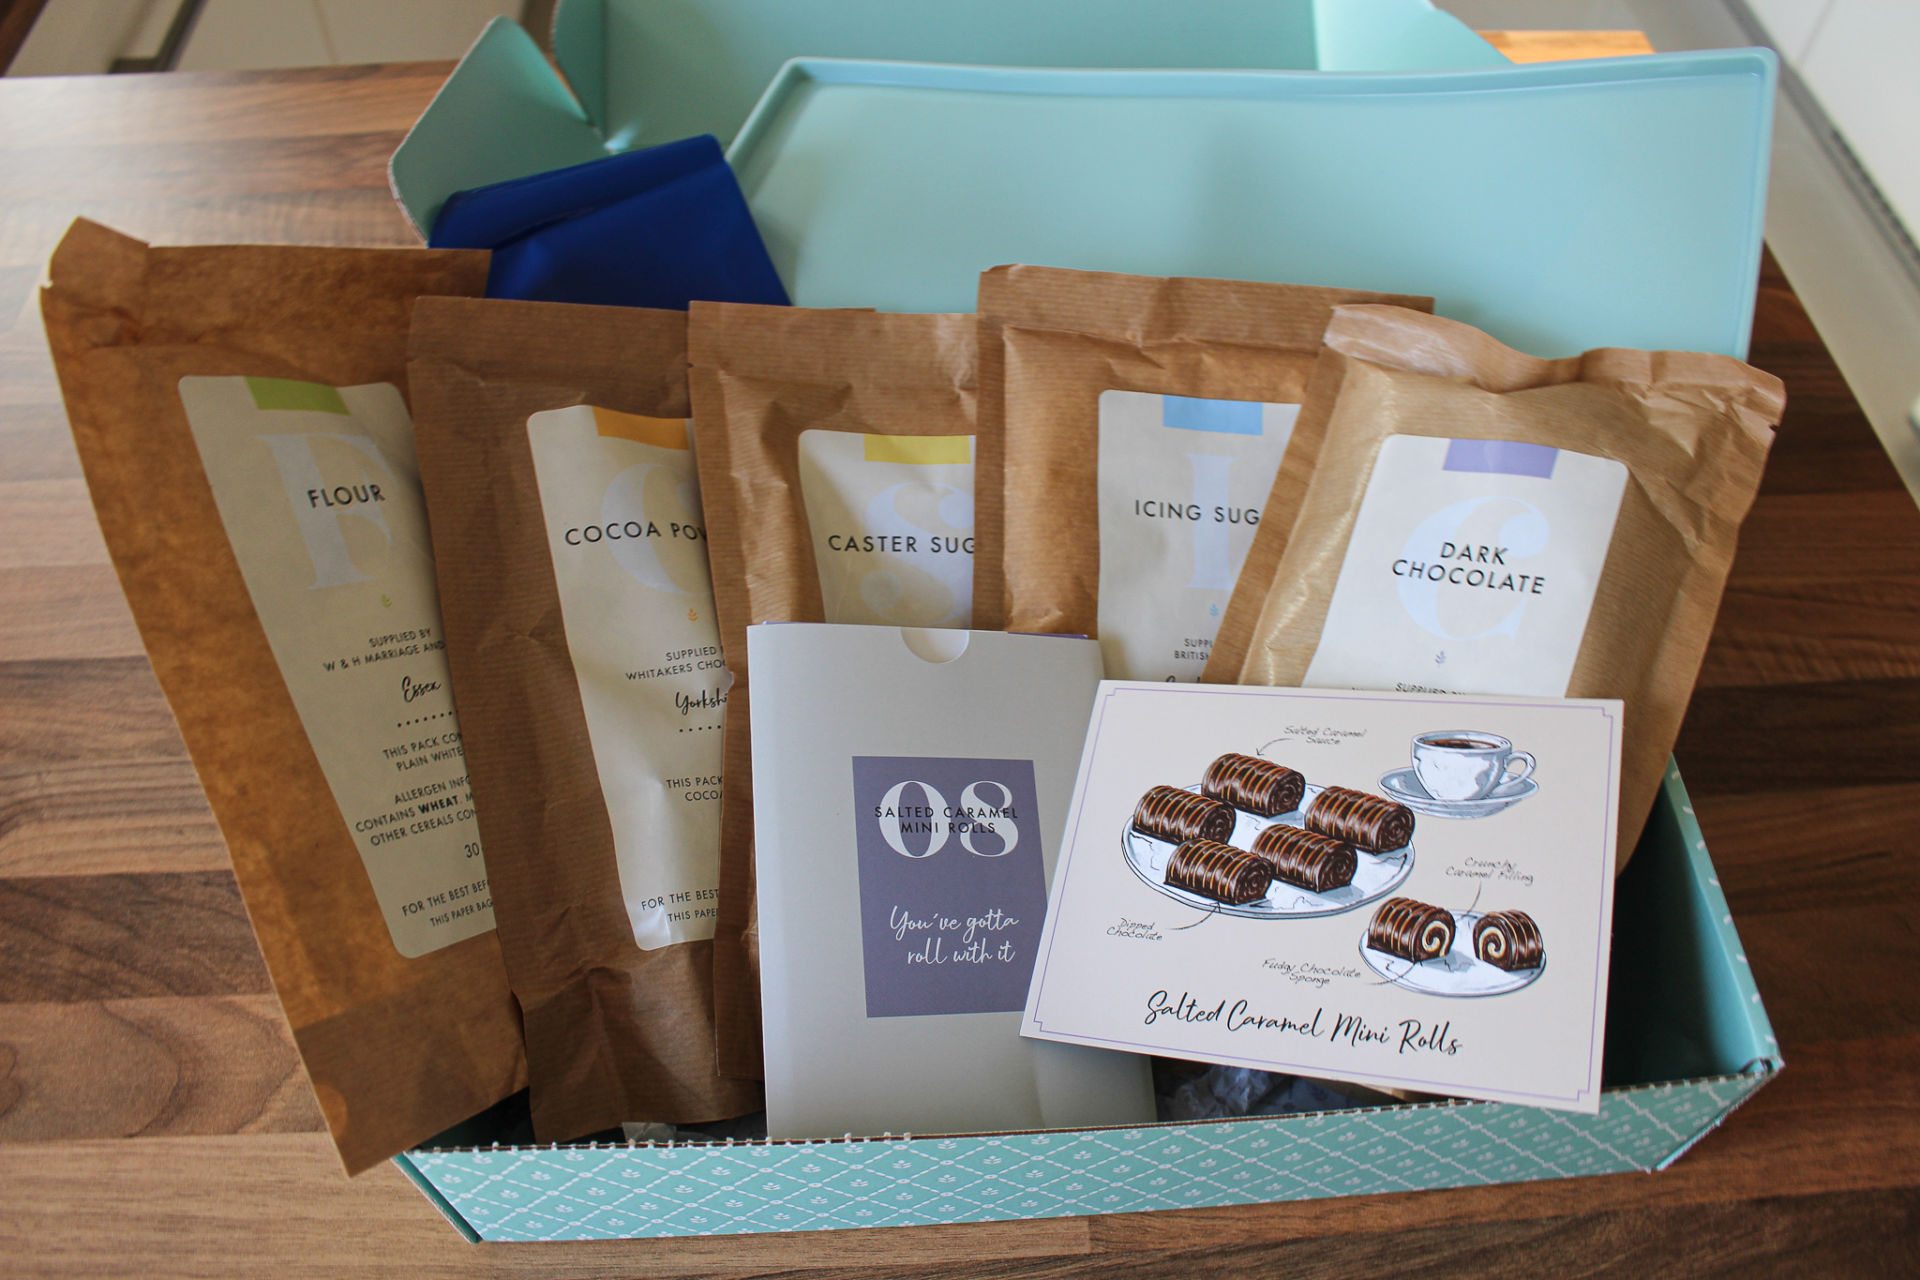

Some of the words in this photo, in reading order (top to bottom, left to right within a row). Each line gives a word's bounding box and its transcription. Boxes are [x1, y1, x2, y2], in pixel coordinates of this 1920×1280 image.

[307, 484, 385, 508] FLOUR
[1135, 499, 1202, 521] ICING
[1214, 505, 1260, 526] SUG
[565, 521, 662, 546] COCOA
[828, 535, 918, 553] CASTER
[930, 537, 975, 554] SUG
[1440, 541, 1509, 566] DARK
[1392, 559, 1546, 595] CHOCOLATE
[368, 630, 417, 648] SUPPLIED
[419, 628, 432, 639] BY
[322, 661, 336, 672] W
[340, 659, 349, 670] &
[352, 656, 361, 667] H
[364, 644, 420, 664] MARRIAGE
[423, 640, 447, 652] AND
[666, 646, 717, 662] SUPPLIED
[625, 662, 693, 681] WHITAKERS
[401, 675, 443, 703] Essex
[382, 745, 409, 760] THIS
[410, 737, 440, 753] PACK
[396, 755, 429, 772] PLAIN
[431, 746, 465, 762] WHITE
[395, 781, 447, 805] ALLERGEN
[666, 777, 692, 790] THIS
[696, 776, 723, 787] PACK
[355, 807, 416, 833] CONTAINS
[874, 806, 934, 819] SALTED
[943, 807, 1019, 820] CARAMEL
[370, 827, 408, 847] OTHER
[410, 813, 455, 835] CEREALS
[901, 822, 939, 834] MINI
[949, 822, 996, 834] ROLLS
[464, 841, 480, 859] 30
[402, 900, 426, 917] FOR
[427, 892, 447, 908] THE
[448, 884, 471, 902] BEST
[641, 896, 665, 911] FOR
[669, 892, 692, 904] THE
[695, 888, 719, 901] BEST
[429, 913, 450, 928] THIS
[451, 904, 476, 920] PAPER
[476, 897, 494, 912] BAG
[667, 911, 691, 923] THIS
[890, 905, 962, 942] You've
[962, 908, 1020, 944] gotta
[1119, 917, 1156, 932] Dipped
[1106, 926, 1163, 941] Chocolate
[907, 937, 948, 966] roll
[952, 937, 993, 964] with
[998, 940, 1017, 964] it
[1262, 958, 1296, 976] Fudgy
[1300, 962, 1362, 978] Chocolate
[1289, 972, 1331, 989] Sponge
[1144, 989, 1226, 1026] Salted
[1227, 999, 1326, 1038] Caramel
[1331, 1012, 1391, 1048] Mini
[1398, 1018, 1463, 1056] Rolls
